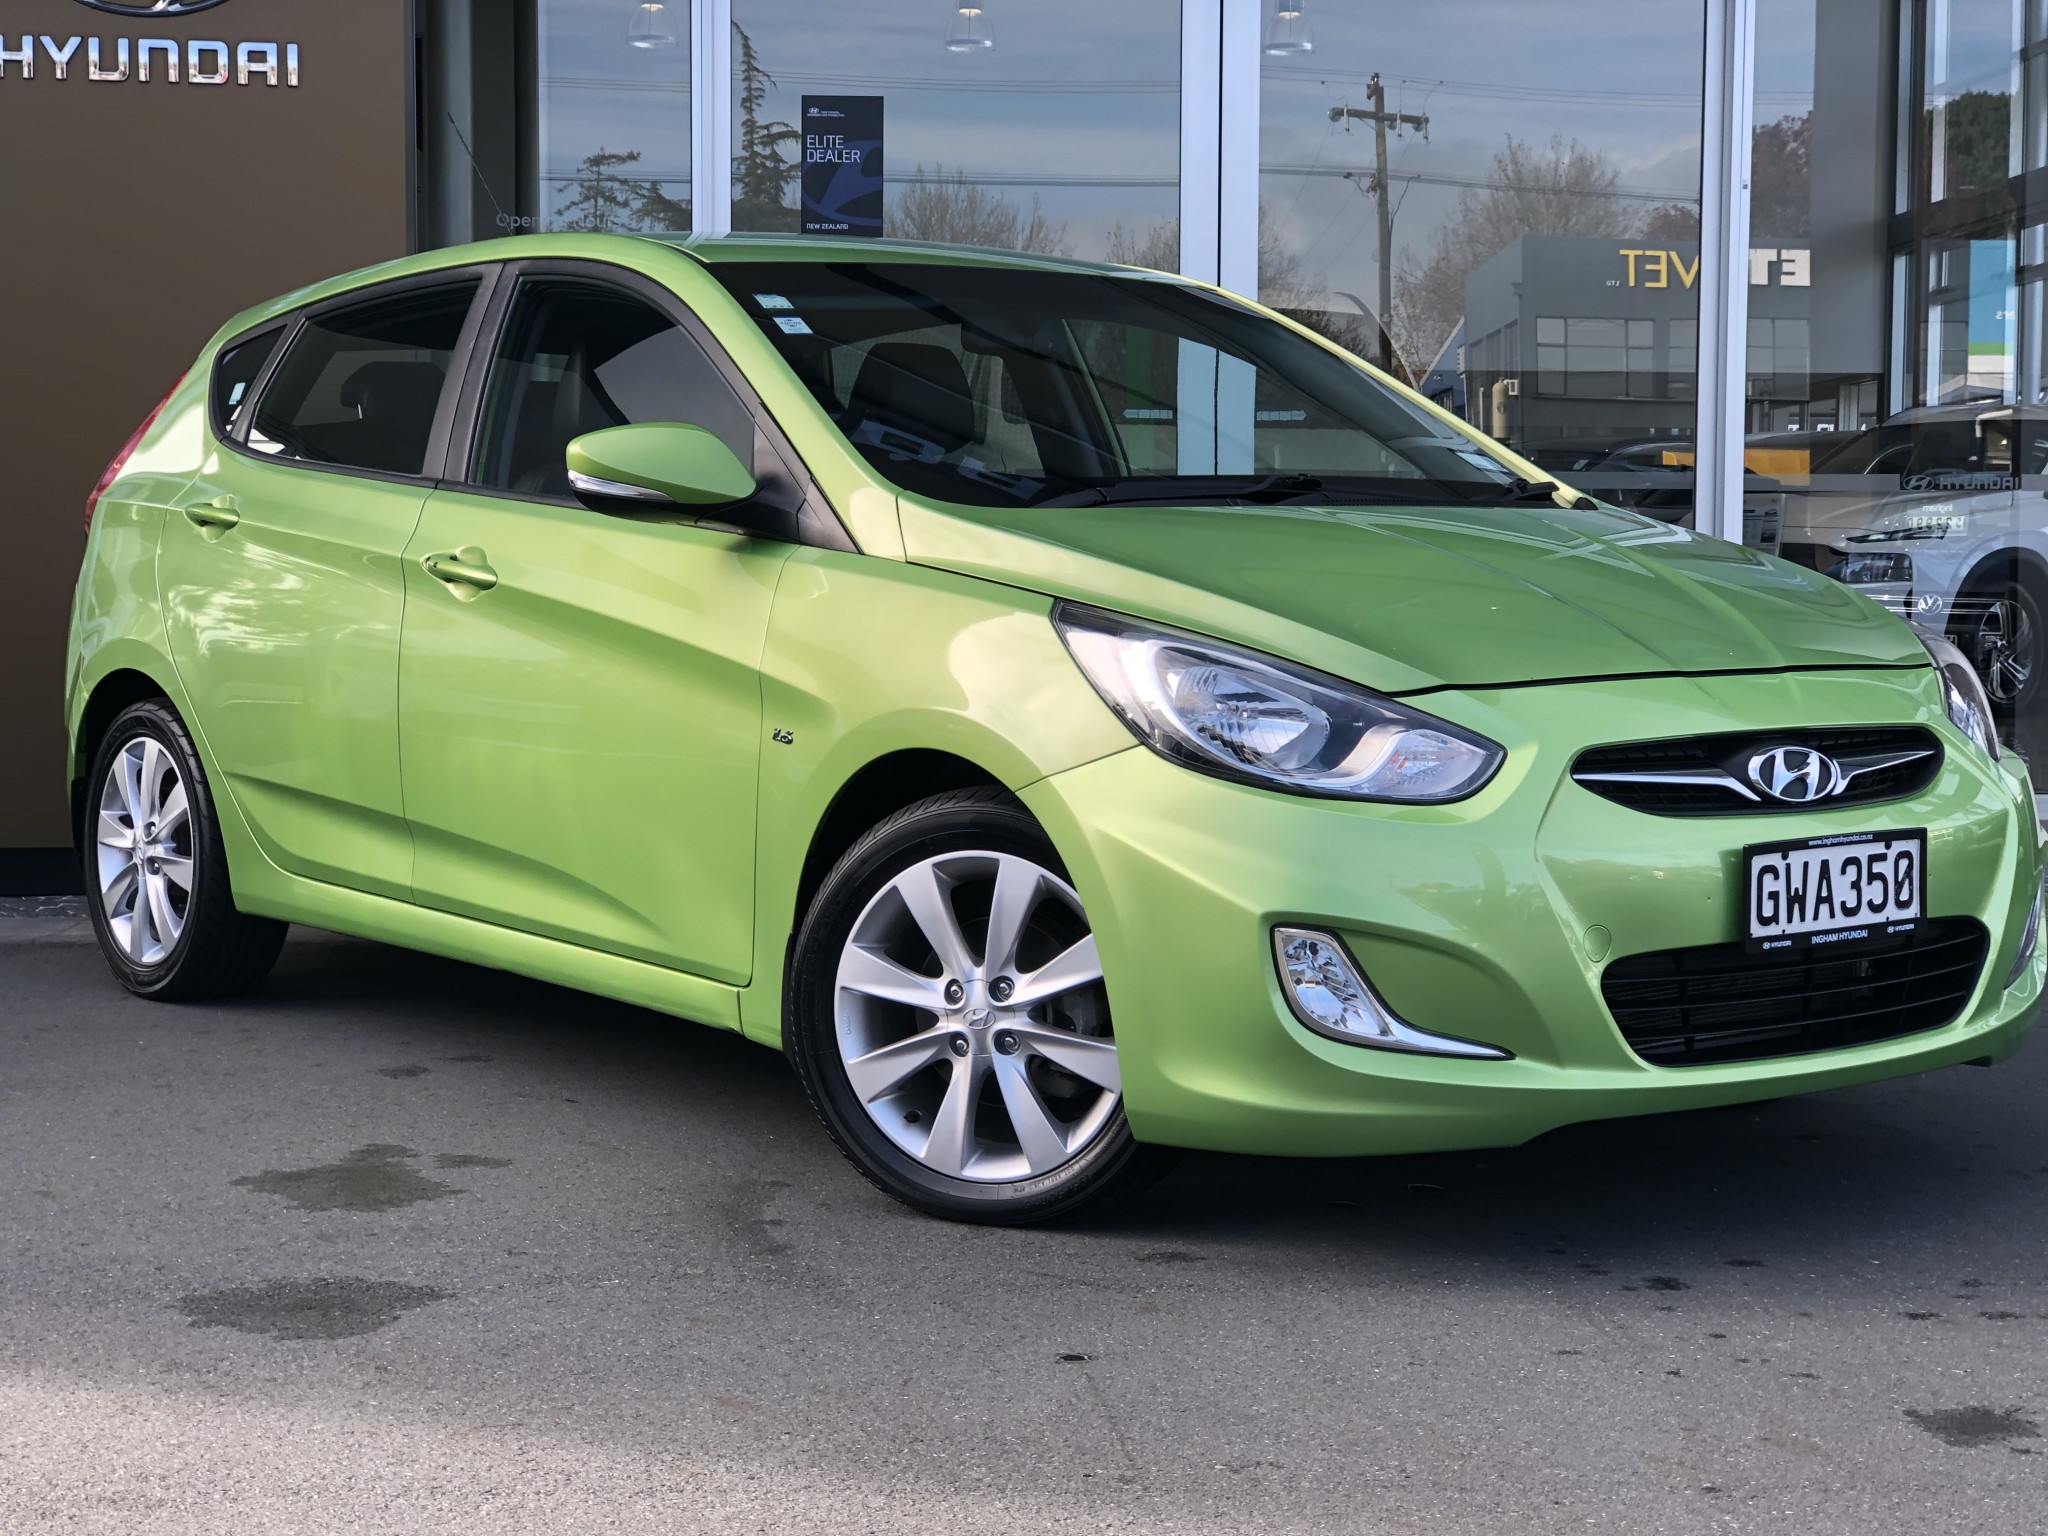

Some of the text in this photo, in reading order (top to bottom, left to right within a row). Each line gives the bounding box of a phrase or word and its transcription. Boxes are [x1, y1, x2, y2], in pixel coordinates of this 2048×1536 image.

[0, 34, 299, 87] HYUNDAI
[806, 134, 844, 148] ELITE
[806, 149, 861, 163] DEALER
[1939, 476, 2019, 490] HYUNDAI
[1808, 834, 1873, 846] www.inghamhyundai.co.nz
[1757, 850, 1914, 926] GWA350
[1811, 929, 1868, 944] INGHAM HYUNDAI
